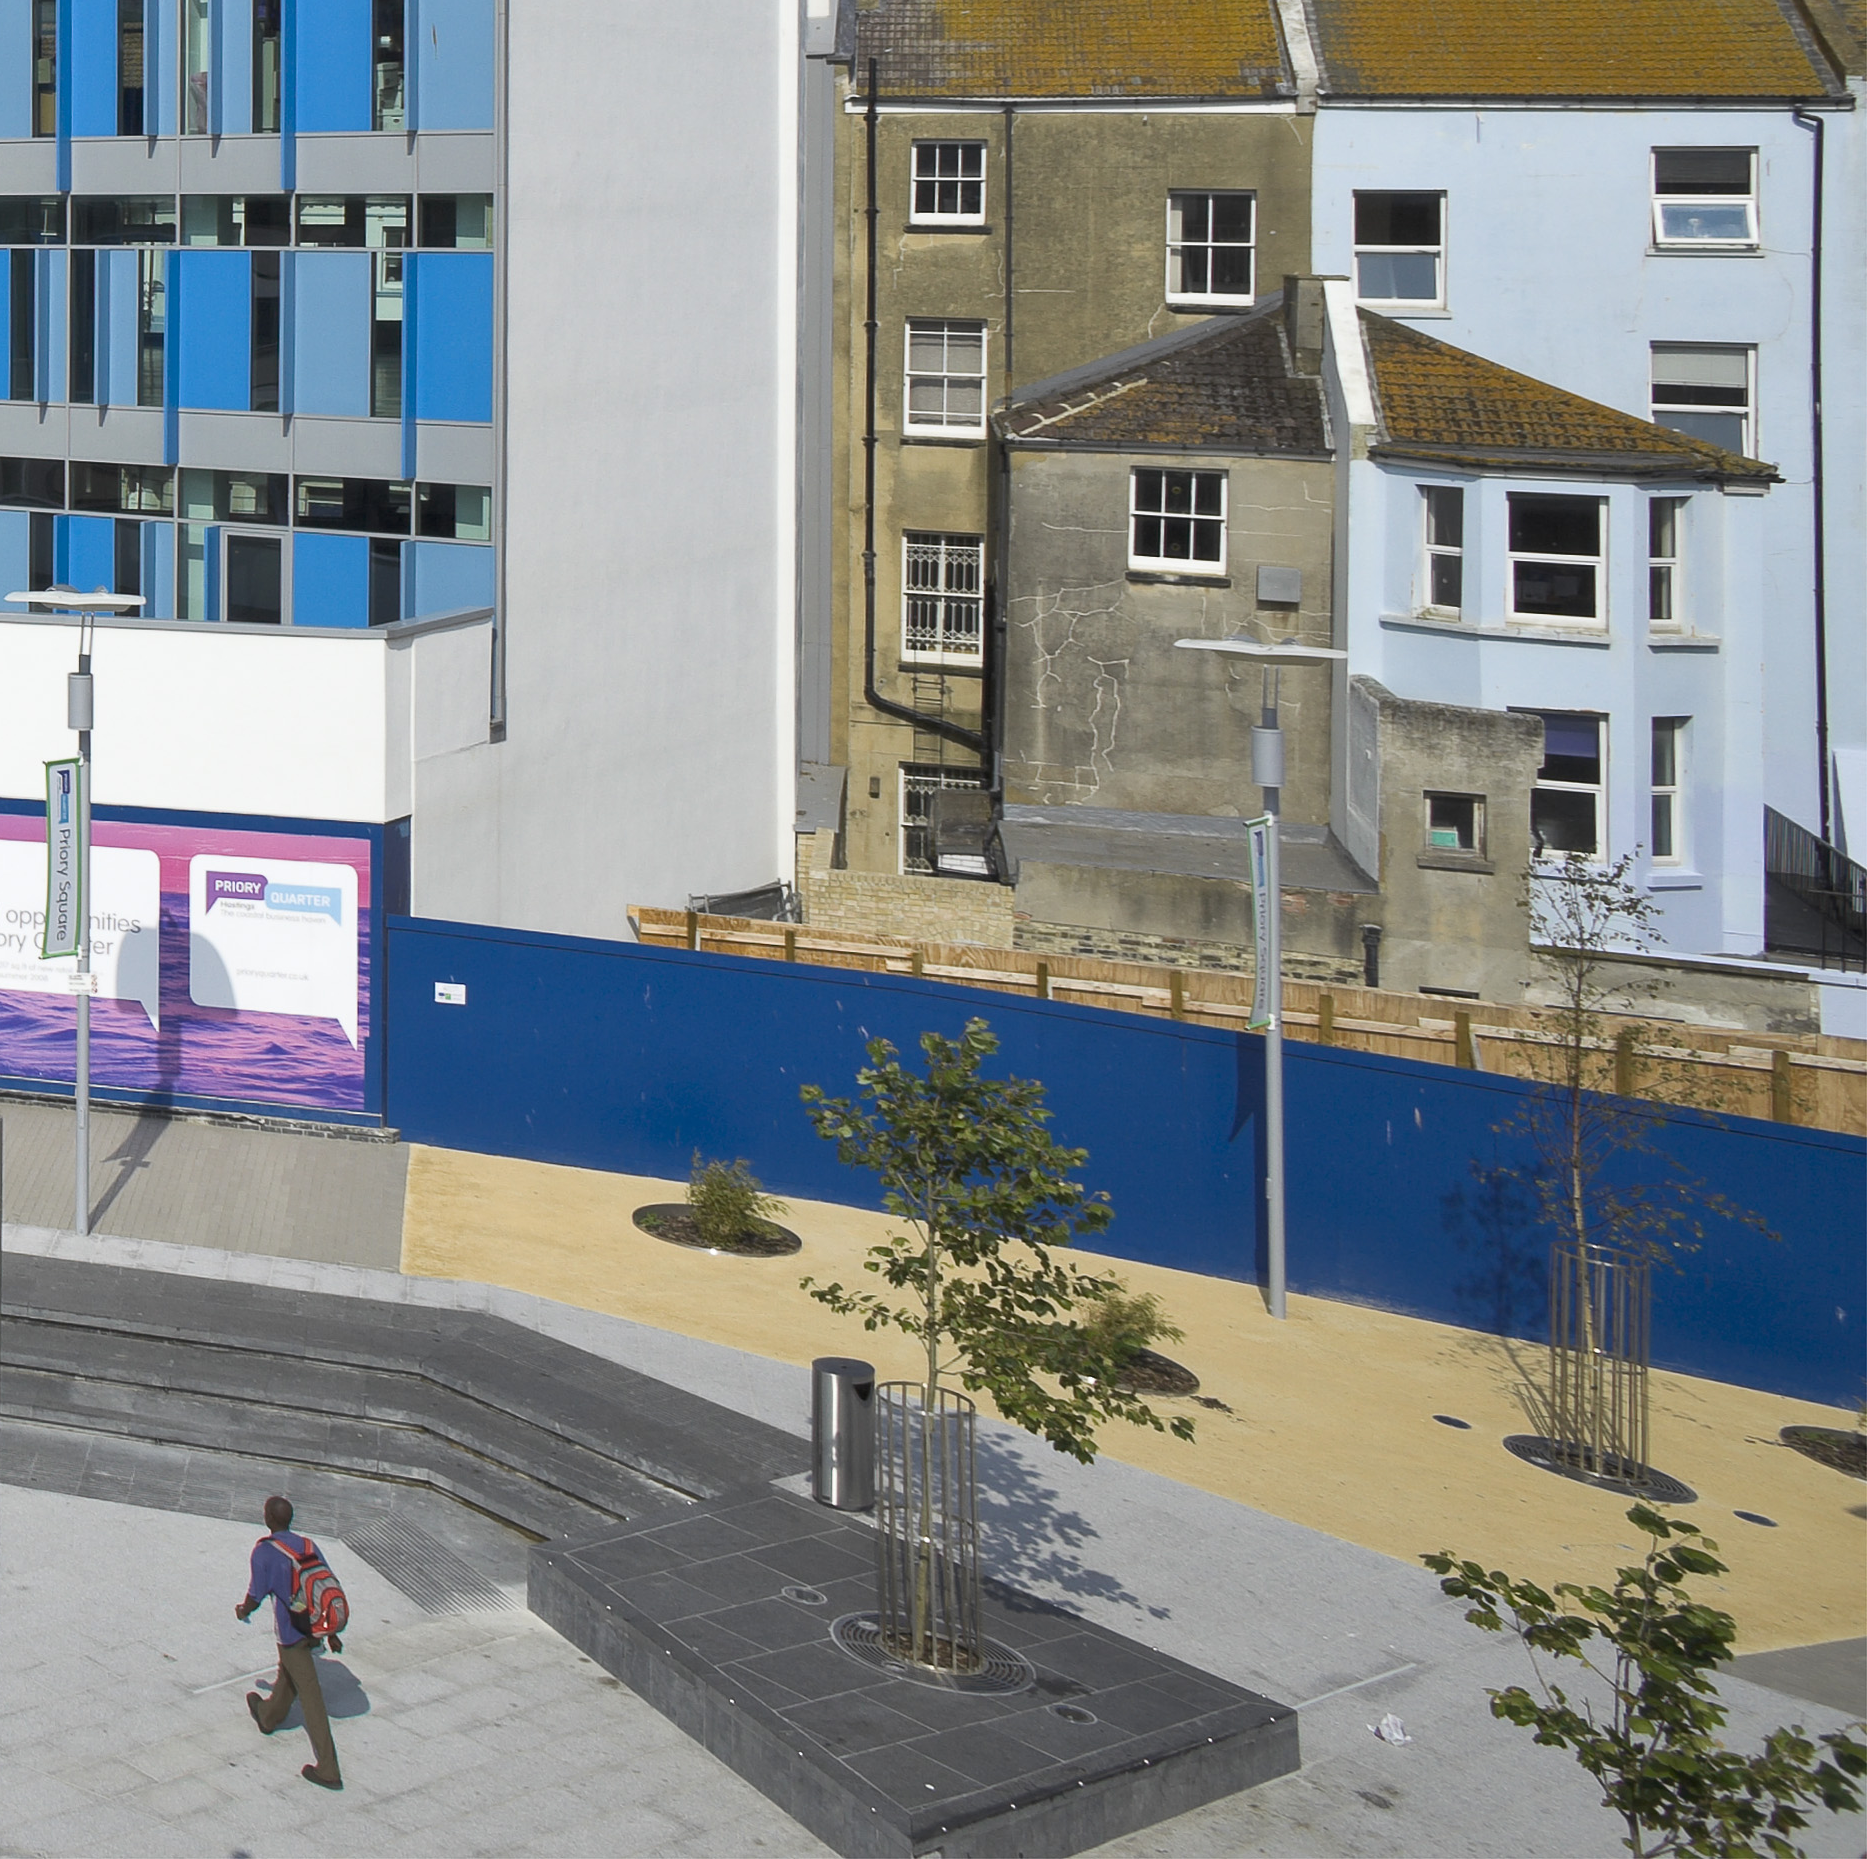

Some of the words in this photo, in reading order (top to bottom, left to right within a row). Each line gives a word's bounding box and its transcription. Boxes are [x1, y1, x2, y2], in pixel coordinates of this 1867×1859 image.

[56, 828, 71, 877] Priory
[215, 880, 261, 894] PRIORY
[271, 892, 331, 907] QUARTER
[220, 901, 255, 911] Hastings
[6, 908, 141, 934] oppnities
[56, 880, 71, 942] Square
